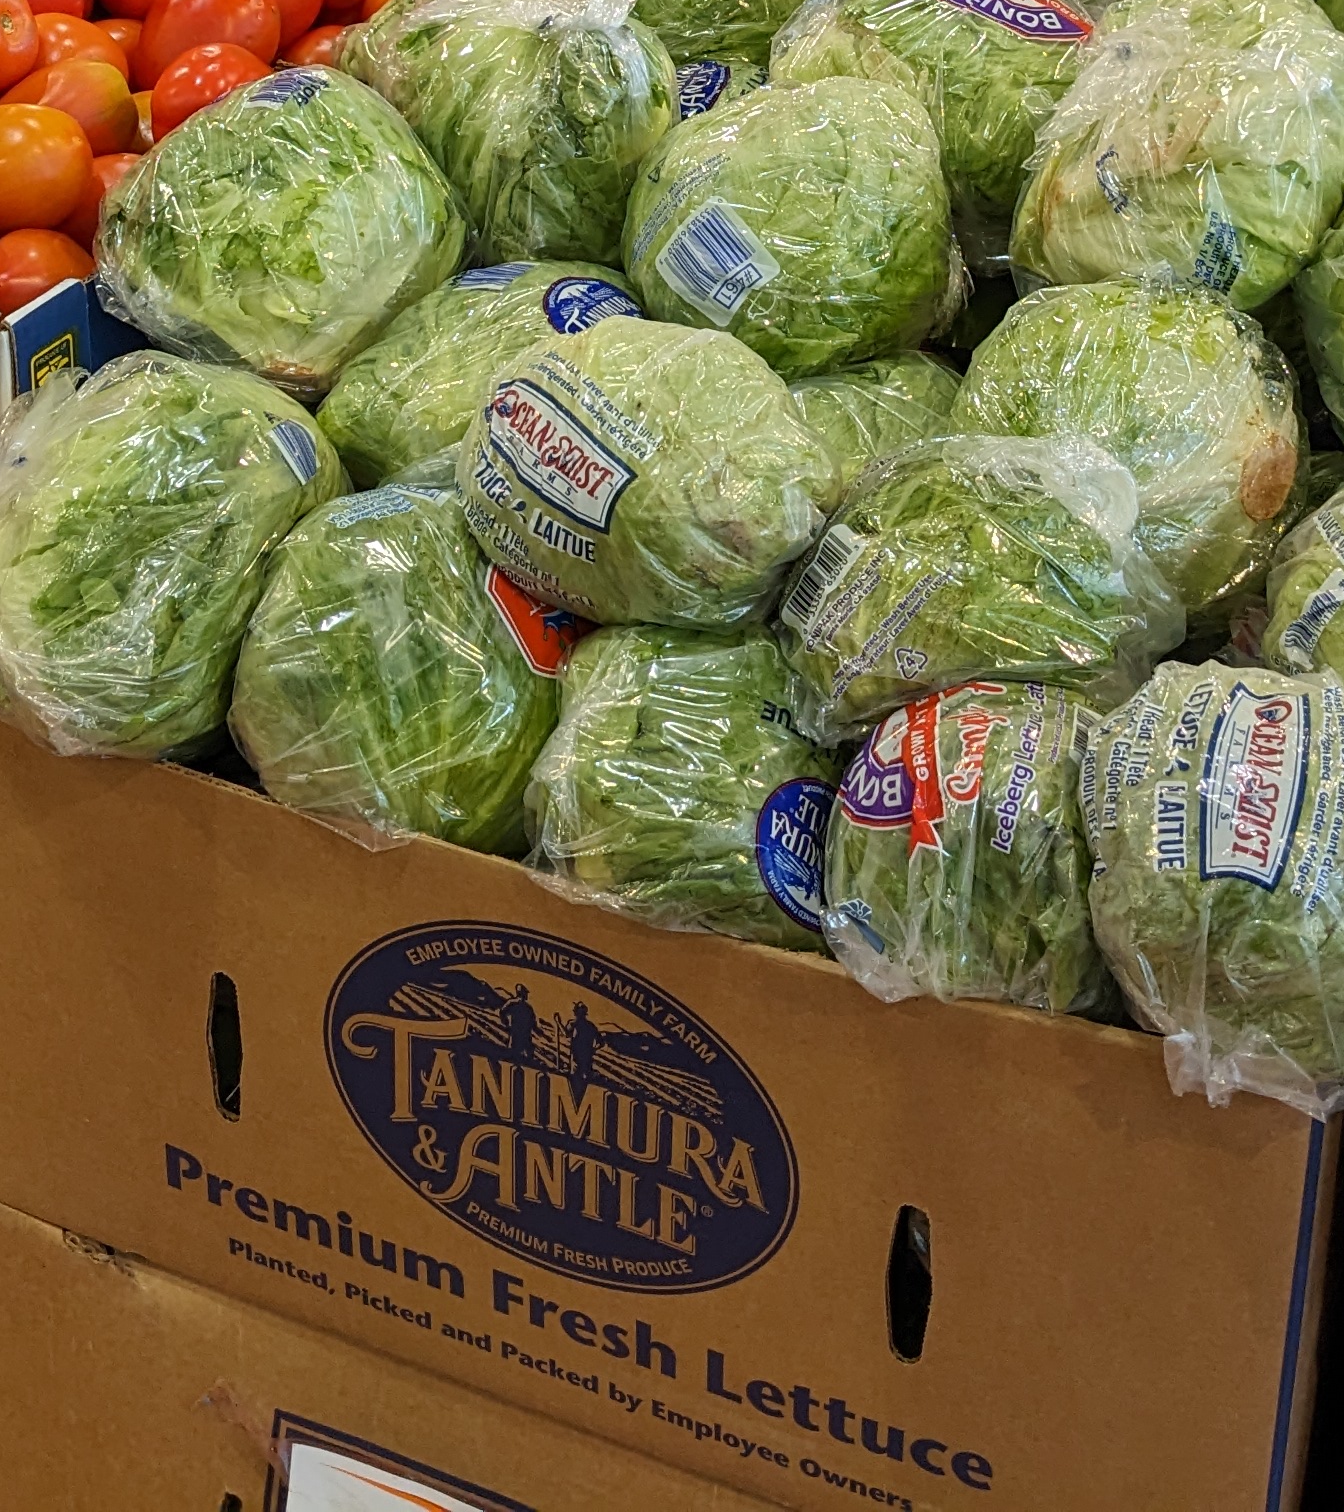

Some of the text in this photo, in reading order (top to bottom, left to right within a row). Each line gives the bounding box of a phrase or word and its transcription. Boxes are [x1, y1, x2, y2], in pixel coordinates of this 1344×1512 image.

[533, 512, 596, 562] LAITUE
[991, 759, 1034, 853] Iceberg
[1158, 785, 1186, 869] LAITUE
[406, 938, 718, 1064] EMPLOYEE OWNED FAMILY FARM
[341, 1012, 769, 1214] TANIMURA
[413, 1124, 697, 1256] & ANTLE
[466, 1200, 692, 1278] PREMIUM FRESH PRODUCE
[165, 1143, 994, 1491] Premium Fresh Lettuce
[228, 1237, 913, 1512] Planted, Picked and Packed by Employee Owners
